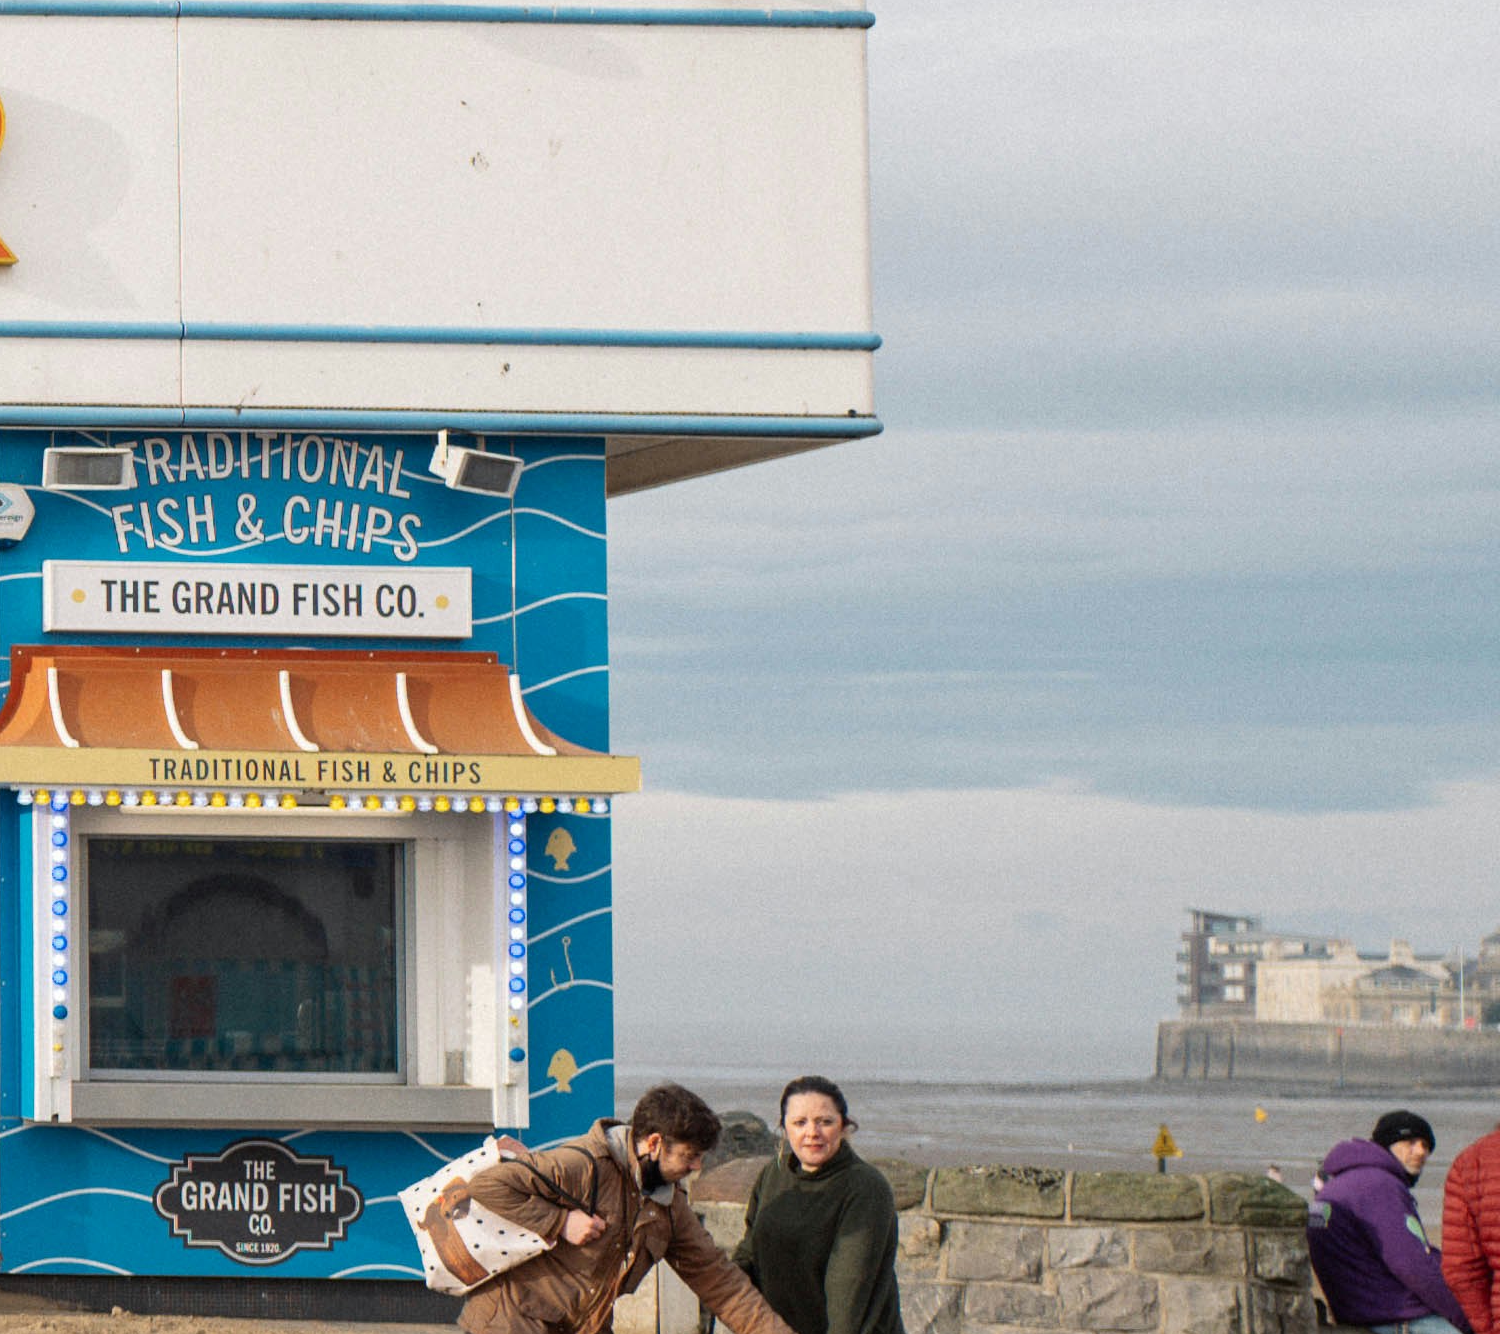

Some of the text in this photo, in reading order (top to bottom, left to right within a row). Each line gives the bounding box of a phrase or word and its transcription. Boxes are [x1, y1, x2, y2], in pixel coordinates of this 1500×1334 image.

[111, 493, 422, 562] FISH & CHIPS
[101, 580, 424, 618] THE GRAND FISH CO.
[149, 758, 482, 784] TRADITIONAL FISH & CHIPS
[243, 1160, 276, 1180] THE
[181, 1181, 336, 1213] GRAND FISH
[249, 1214, 276, 1235] CO.
[235, 1241, 281, 1253] SINCE 1920.
